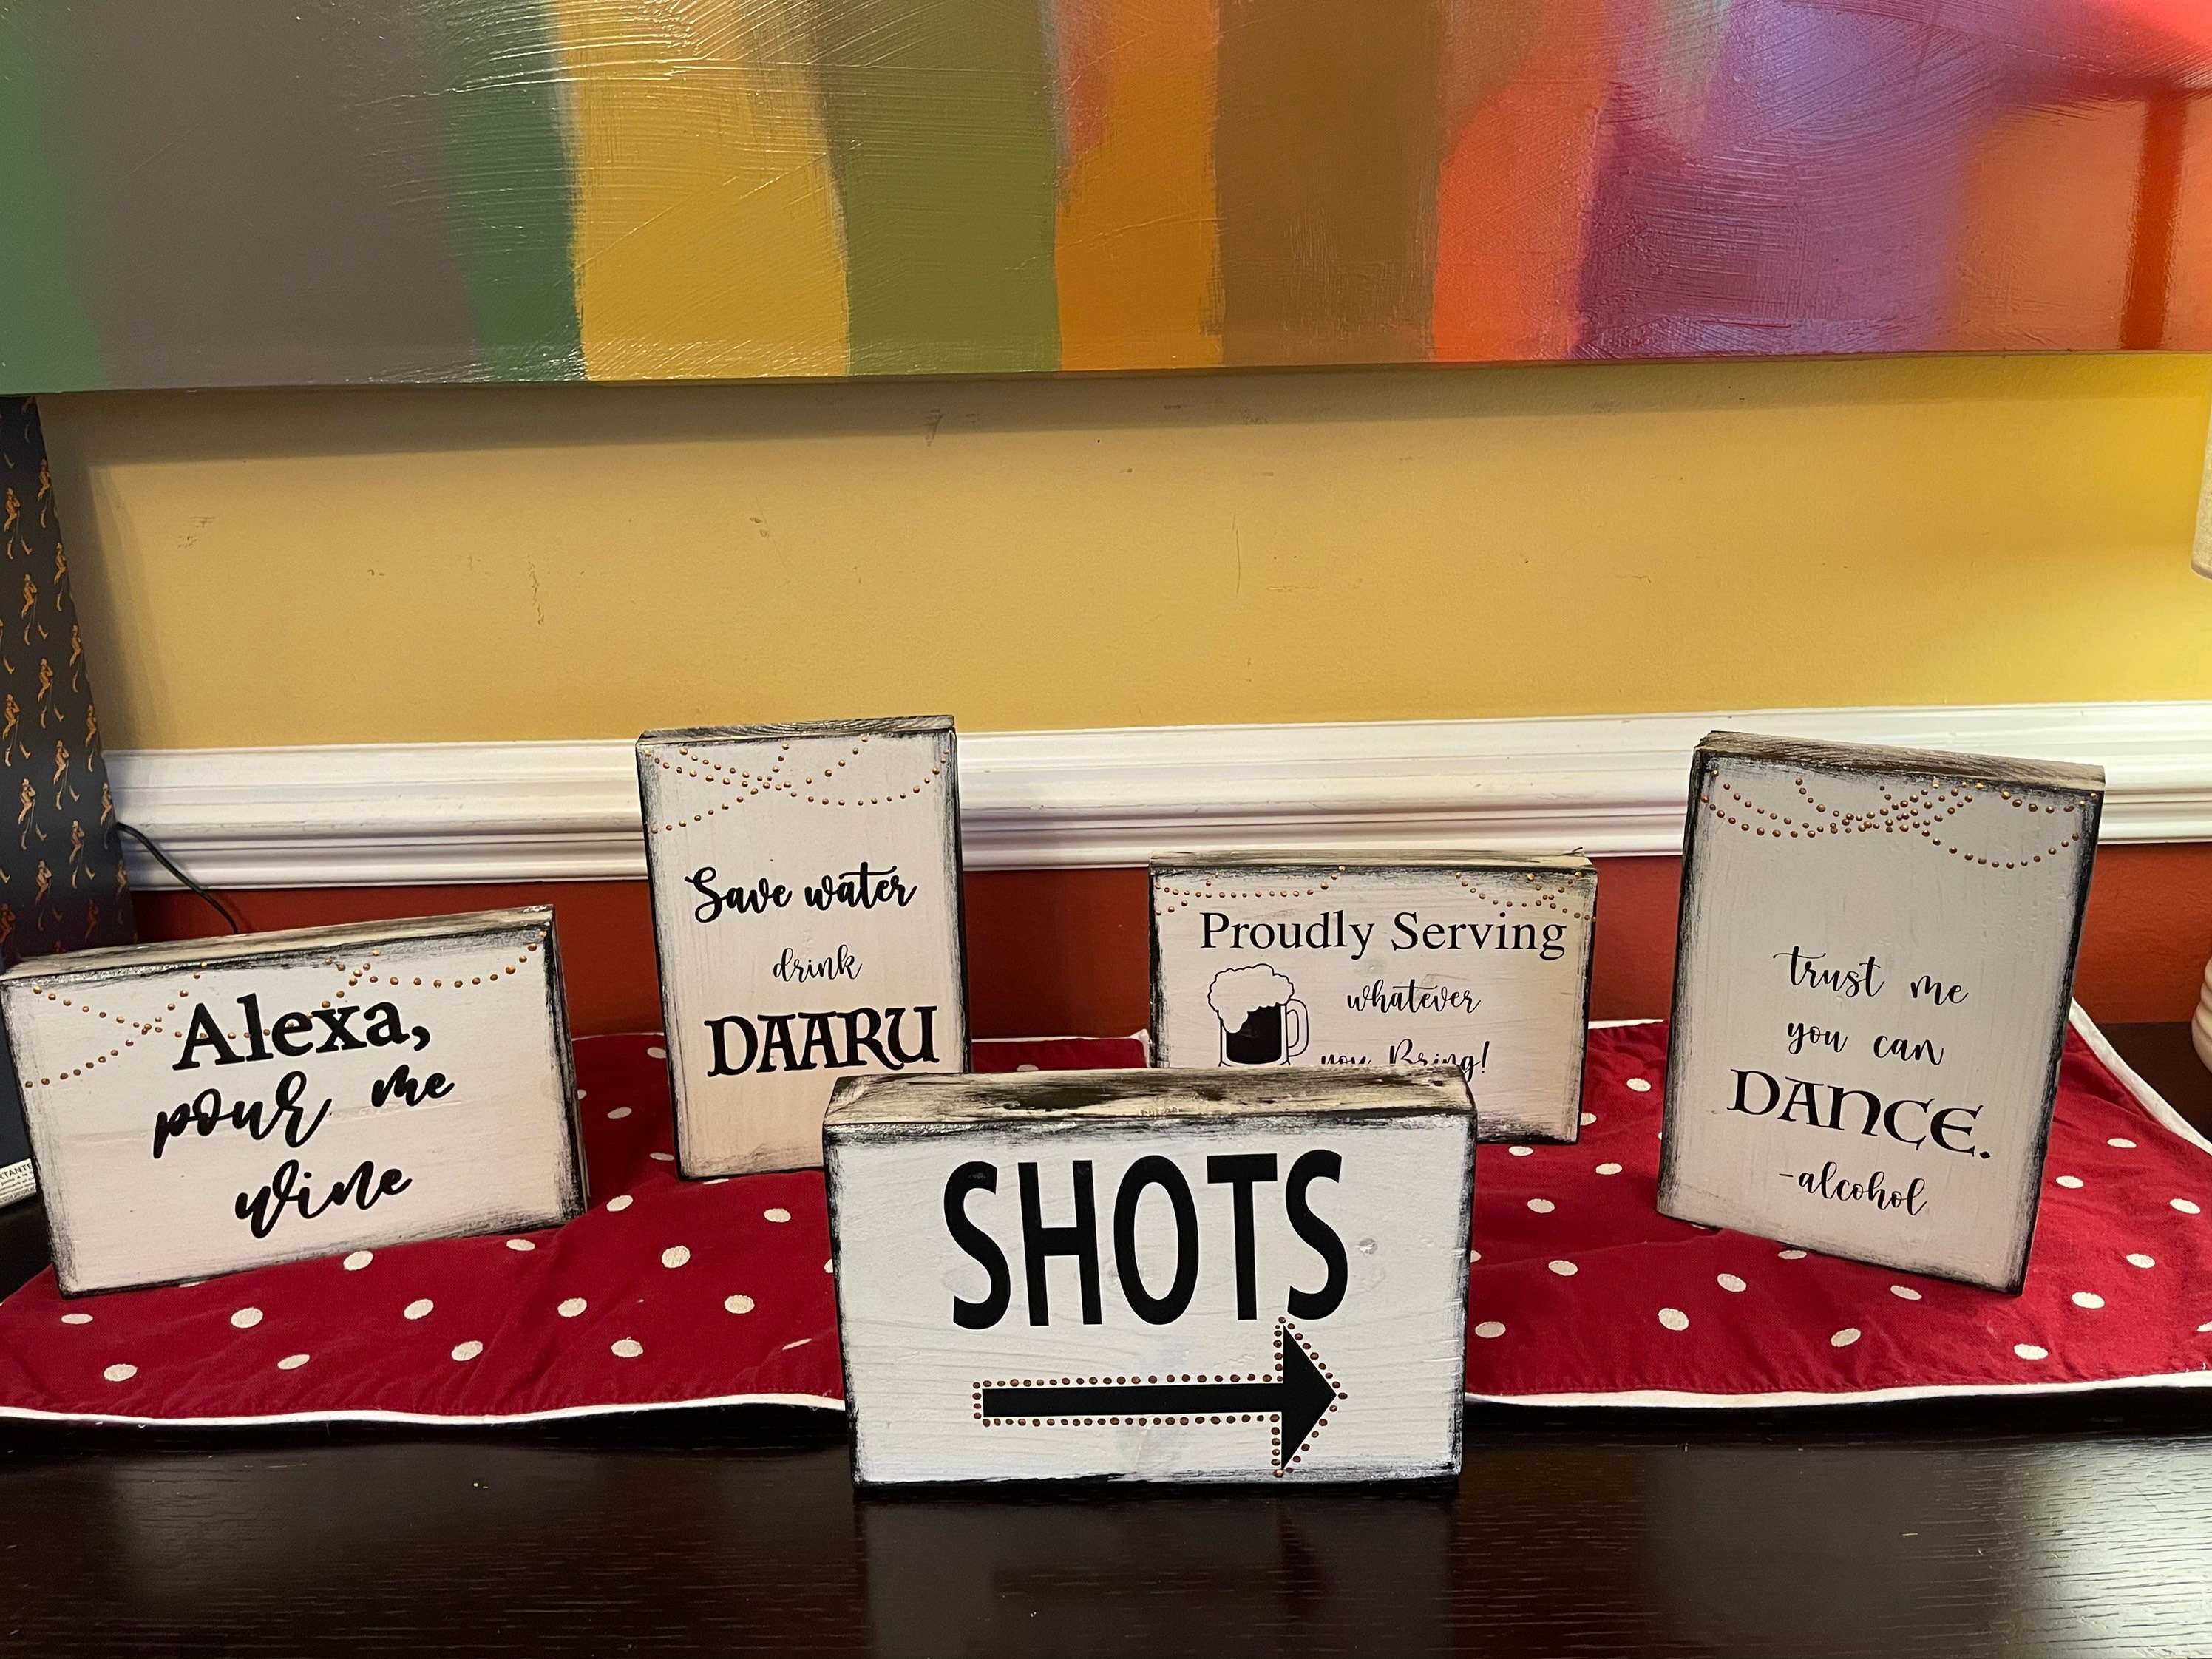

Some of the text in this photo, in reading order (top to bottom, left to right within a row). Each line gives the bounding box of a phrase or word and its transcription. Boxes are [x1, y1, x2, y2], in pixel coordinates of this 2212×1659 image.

[685, 861, 917, 923] Save water
[773, 944, 863, 983] drink
[1199, 910, 1567, 960] Proudly Serving
[1347, 979, 1481, 1014] whatever
[1773, 946, 1969, 1005] trust me
[172, 993, 430, 1070] Alexa,
[704, 1005, 940, 1077] DAARU
[1787, 1022, 1944, 1065] you can
[153, 1065, 455, 1158] pour me
[1727, 1069, 1991, 1159] DANCE.
[235, 1159, 412, 1238] wine
[943, 1149, 1348, 1329] SHOTS
